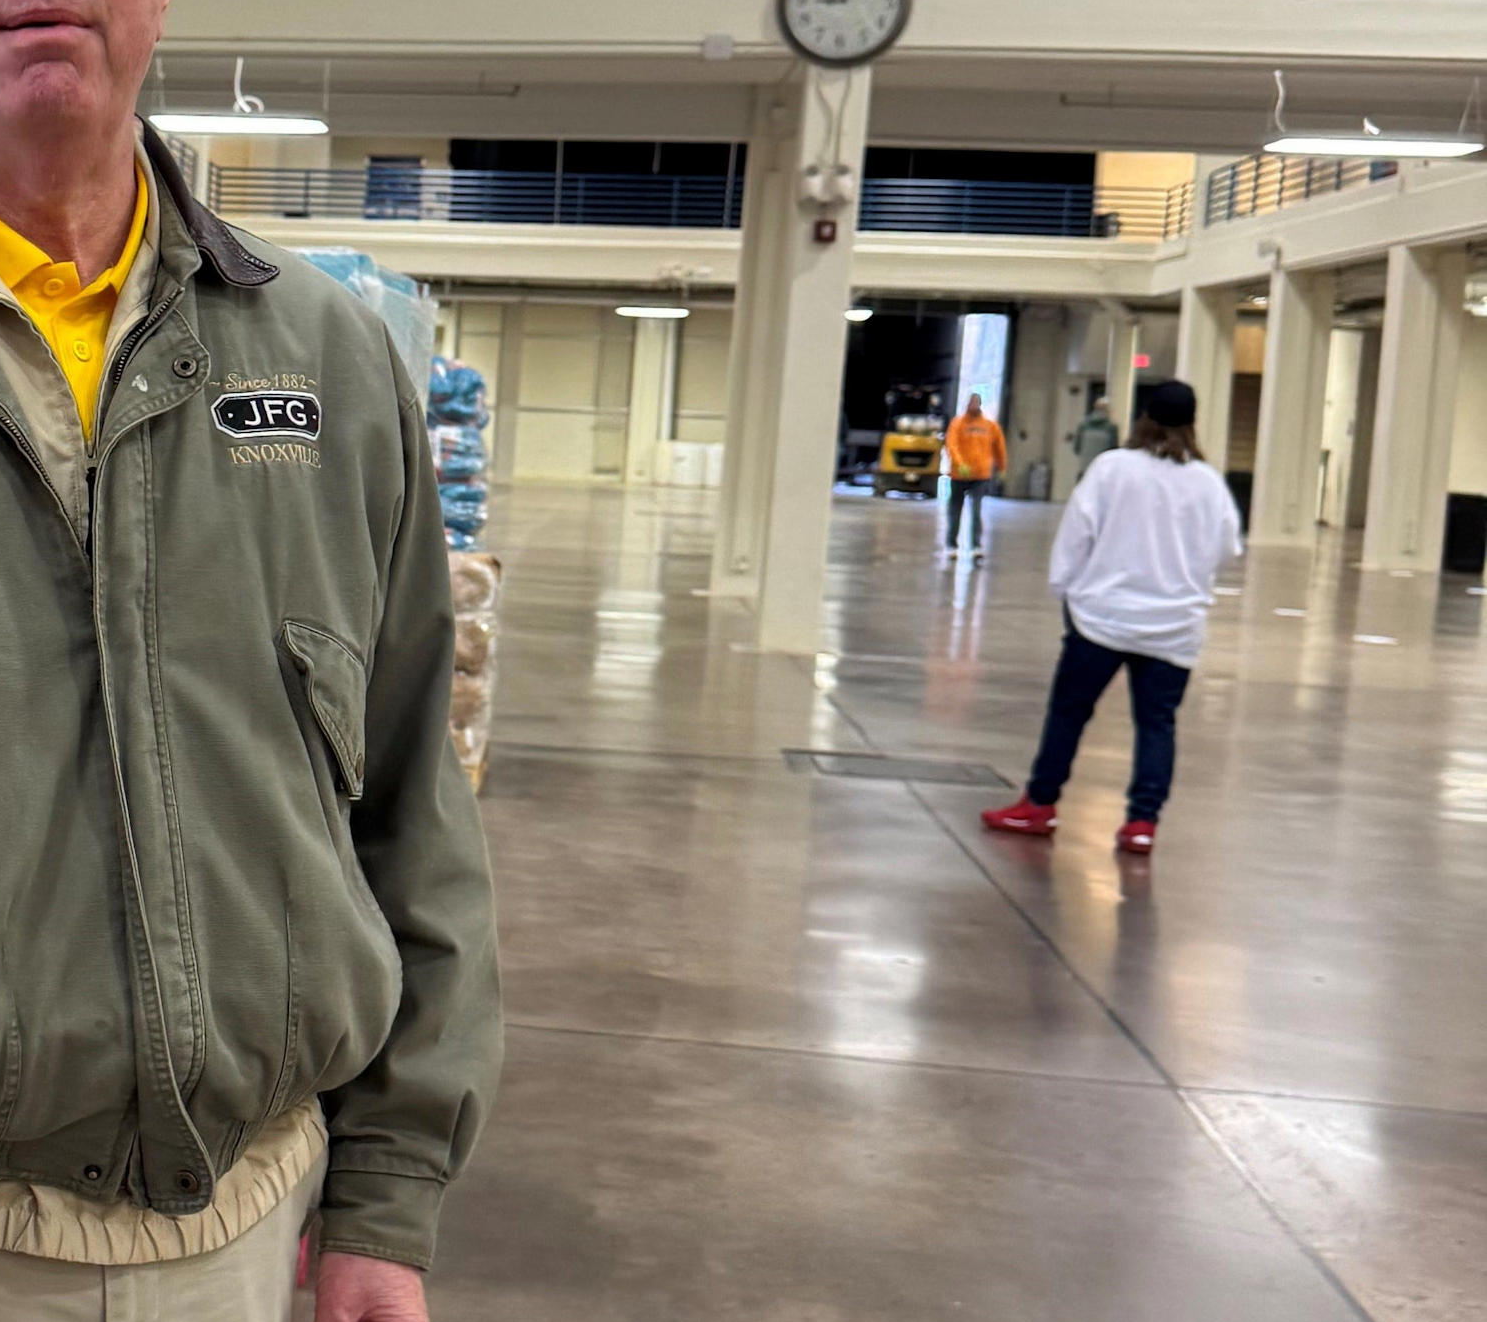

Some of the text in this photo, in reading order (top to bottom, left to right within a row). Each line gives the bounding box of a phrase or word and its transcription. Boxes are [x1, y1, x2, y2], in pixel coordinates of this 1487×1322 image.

[225, 372, 308, 390] Since 1882
[244, 399, 308, 426] JFG
[227, 443, 322, 469] KNOXVILLE
